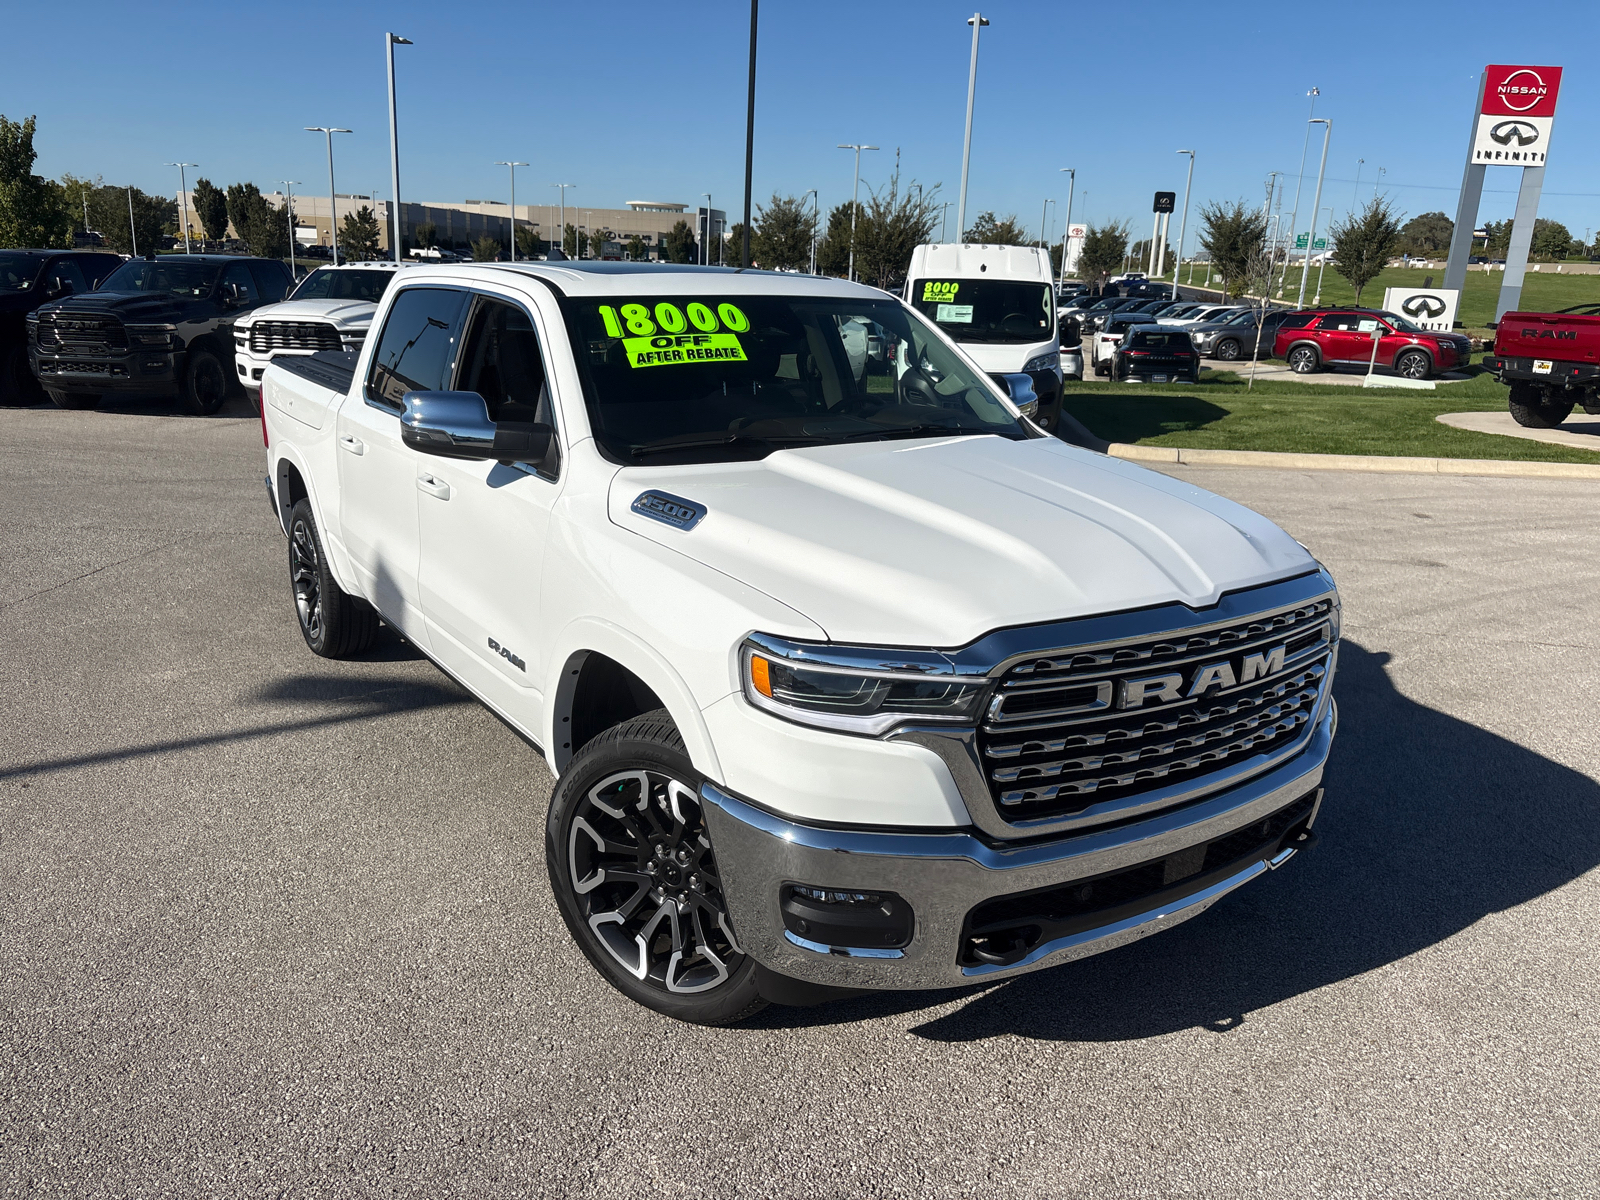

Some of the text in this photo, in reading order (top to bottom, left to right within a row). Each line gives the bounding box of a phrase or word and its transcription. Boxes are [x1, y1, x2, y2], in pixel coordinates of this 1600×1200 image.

[1497, 86, 1547, 95] NISSAN
[1476, 150, 1545, 162] INFINITI
[924, 282, 959, 294] 8000
[56, 320, 101, 329] RAM
[598, 302, 750, 338] 18000
[270, 326, 316, 336] RAM
[1521, 328, 1577, 340] RAM
[650, 335, 712, 348] OFF
[636, 347, 742, 365] AFTER REBATE
[645, 496, 694, 520] 1500
[488, 636, 526, 673] RAM
[1116, 644, 1286, 710] RAM
